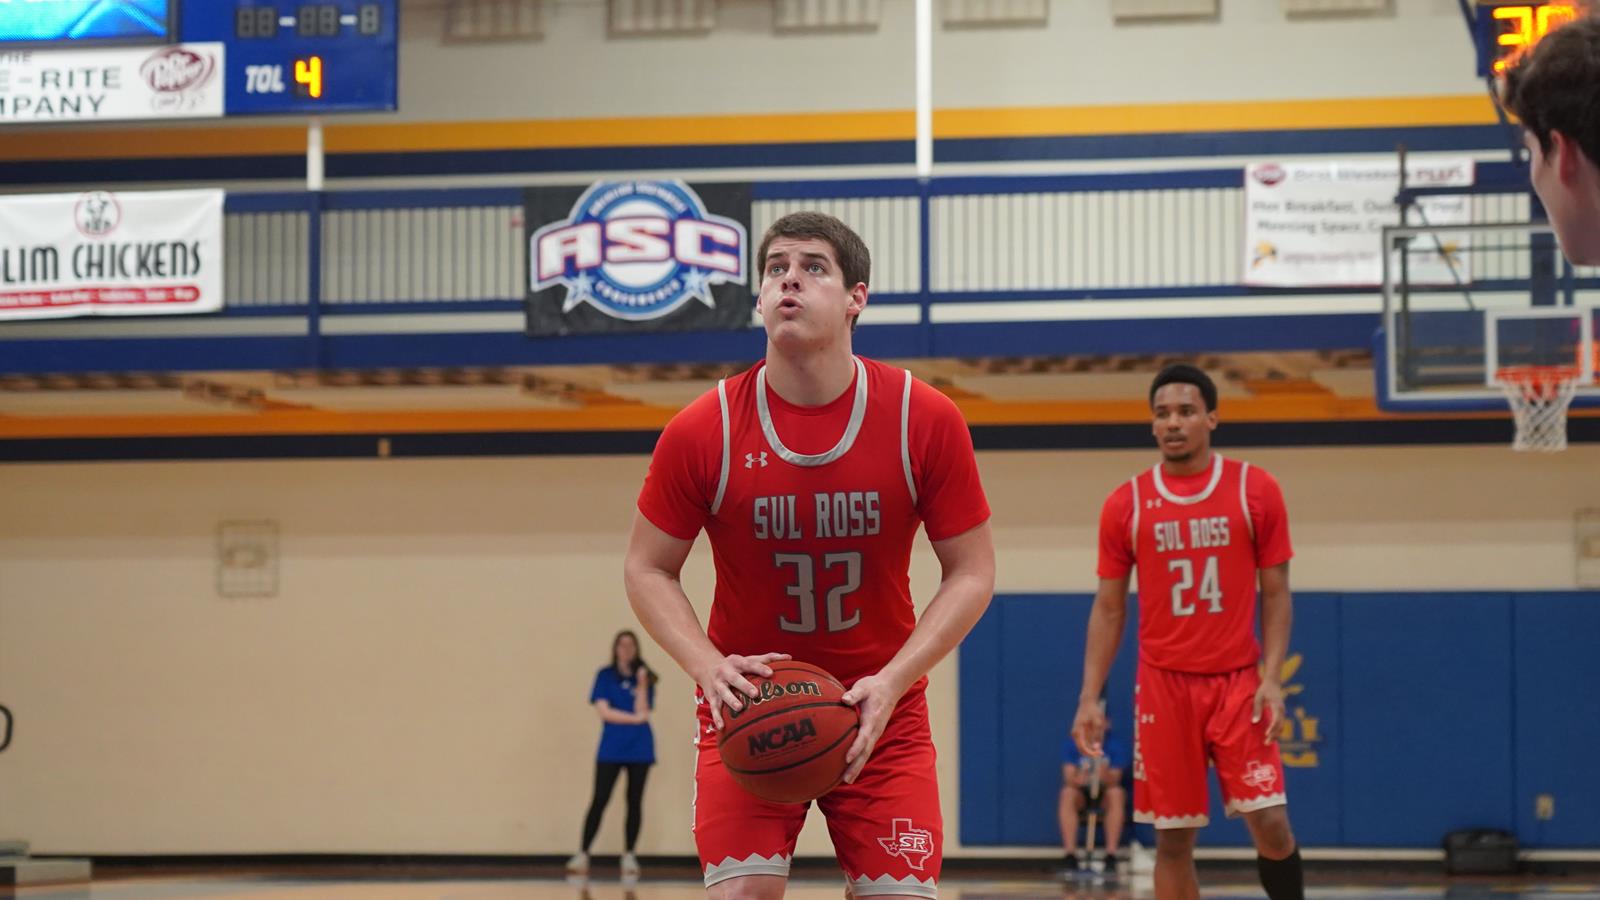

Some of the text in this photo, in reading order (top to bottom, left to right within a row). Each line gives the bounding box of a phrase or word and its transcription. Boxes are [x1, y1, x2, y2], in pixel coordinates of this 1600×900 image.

[245, 56, 322, 98] TOL 4
[0, 241, 201, 283] LIM CHICKENS
[537, 216, 741, 283] ASC
[754, 491, 880, 540] SUL ROSS
[1154, 516, 1230, 553] SUL ROSS
[775, 552, 862, 633] 32
[1168, 556, 1224, 616] 24
[729, 680, 822, 719] ilson
[747, 718, 817, 757] NCAA
[899, 836, 926, 850] SR
